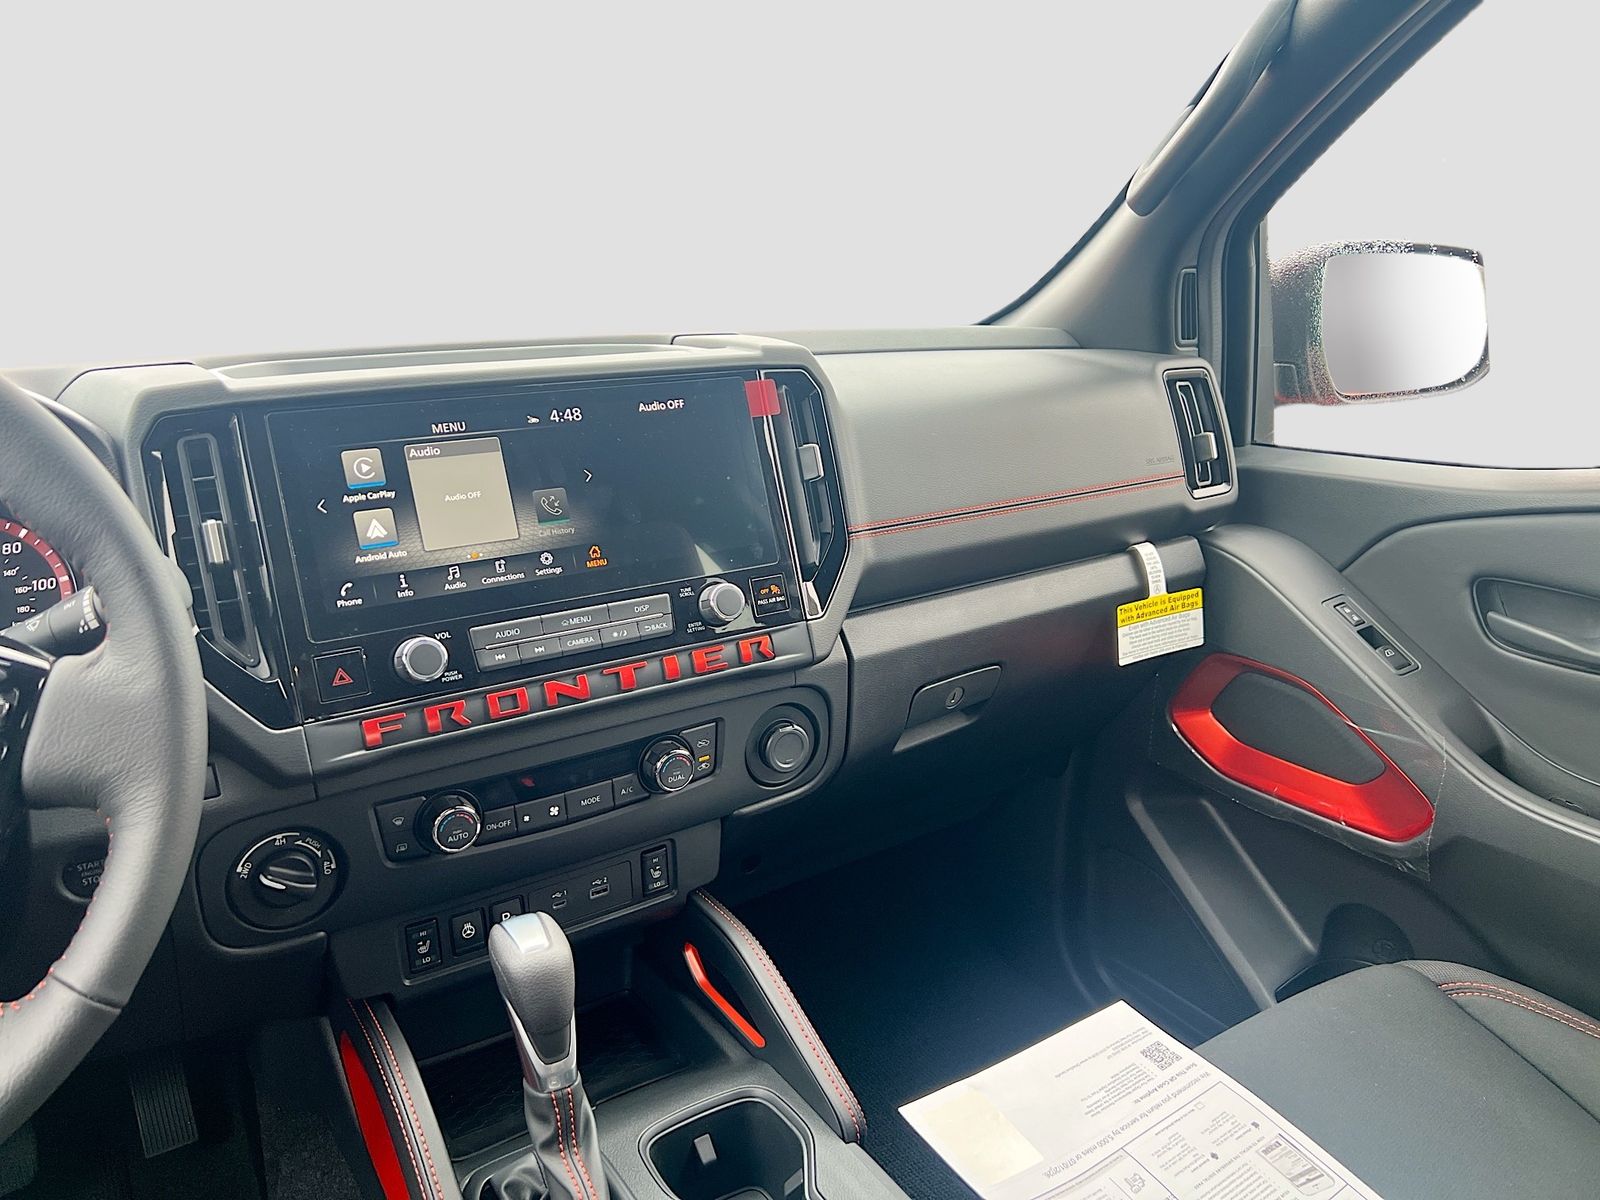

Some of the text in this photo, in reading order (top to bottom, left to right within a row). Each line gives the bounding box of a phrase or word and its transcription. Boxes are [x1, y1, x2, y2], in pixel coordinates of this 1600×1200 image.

[638, 399, 685, 412] Audio OFF
[550, 408, 582, 422] 4:48
[432, 422, 466, 434] MENU
[409, 446, 440, 458] Audio
[342, 490, 396, 504] Apple CarPlay
[444, 490, 482, 502] Audio OFF
[539, 526, 575, 537] Call History
[2, 542, 22, 555] 80
[355, 549, 407, 564] Android Auto
[586, 558, 608, 568] MENU
[535, 566, 563, 576] Settings
[482, 572, 525, 584] Connections
[15, 586, 28, 594] 160
[32, 578, 56, 591] 100
[444, 580, 467, 590] Audio
[397, 588, 414, 598] Info
[336, 597, 362, 608] Phone
[1134, 600, 1158, 611] Vehicle
[1168, 592, 1199, 604] Equipped
[16, 606, 30, 614] 180
[1120, 615, 1134, 624] with
[1136, 607, 1168, 619] Advanced
[1181, 600, 1198, 609] Bags
[569, 615, 592, 624] MENU
[651, 622, 668, 630] BACK
[434, 632, 451, 640] VOL
[495, 628, 520, 638] AUDIO
[567, 636, 594, 646] CAMERA
[442, 674, 462, 682] POWER
[362, 634, 775, 747] FRONTIER
[668, 774, 685, 782] DUAL
[621, 786, 633, 795] A/C
[581, 795, 600, 806] MODE
[486, 820, 512, 830] ON-OFF
[274, 838, 286, 846] 4H
[306, 837, 320, 849] PUSH
[448, 832, 468, 843] AUTO
[240, 862, 252, 879] 2WD
[82, 876, 100, 886] STO
[422, 956, 430, 964] LO
[1119, 1117, 1140, 1131] service
[1112, 1129, 1121, 1137] by
[1081, 1144, 1097, 1157] miles
